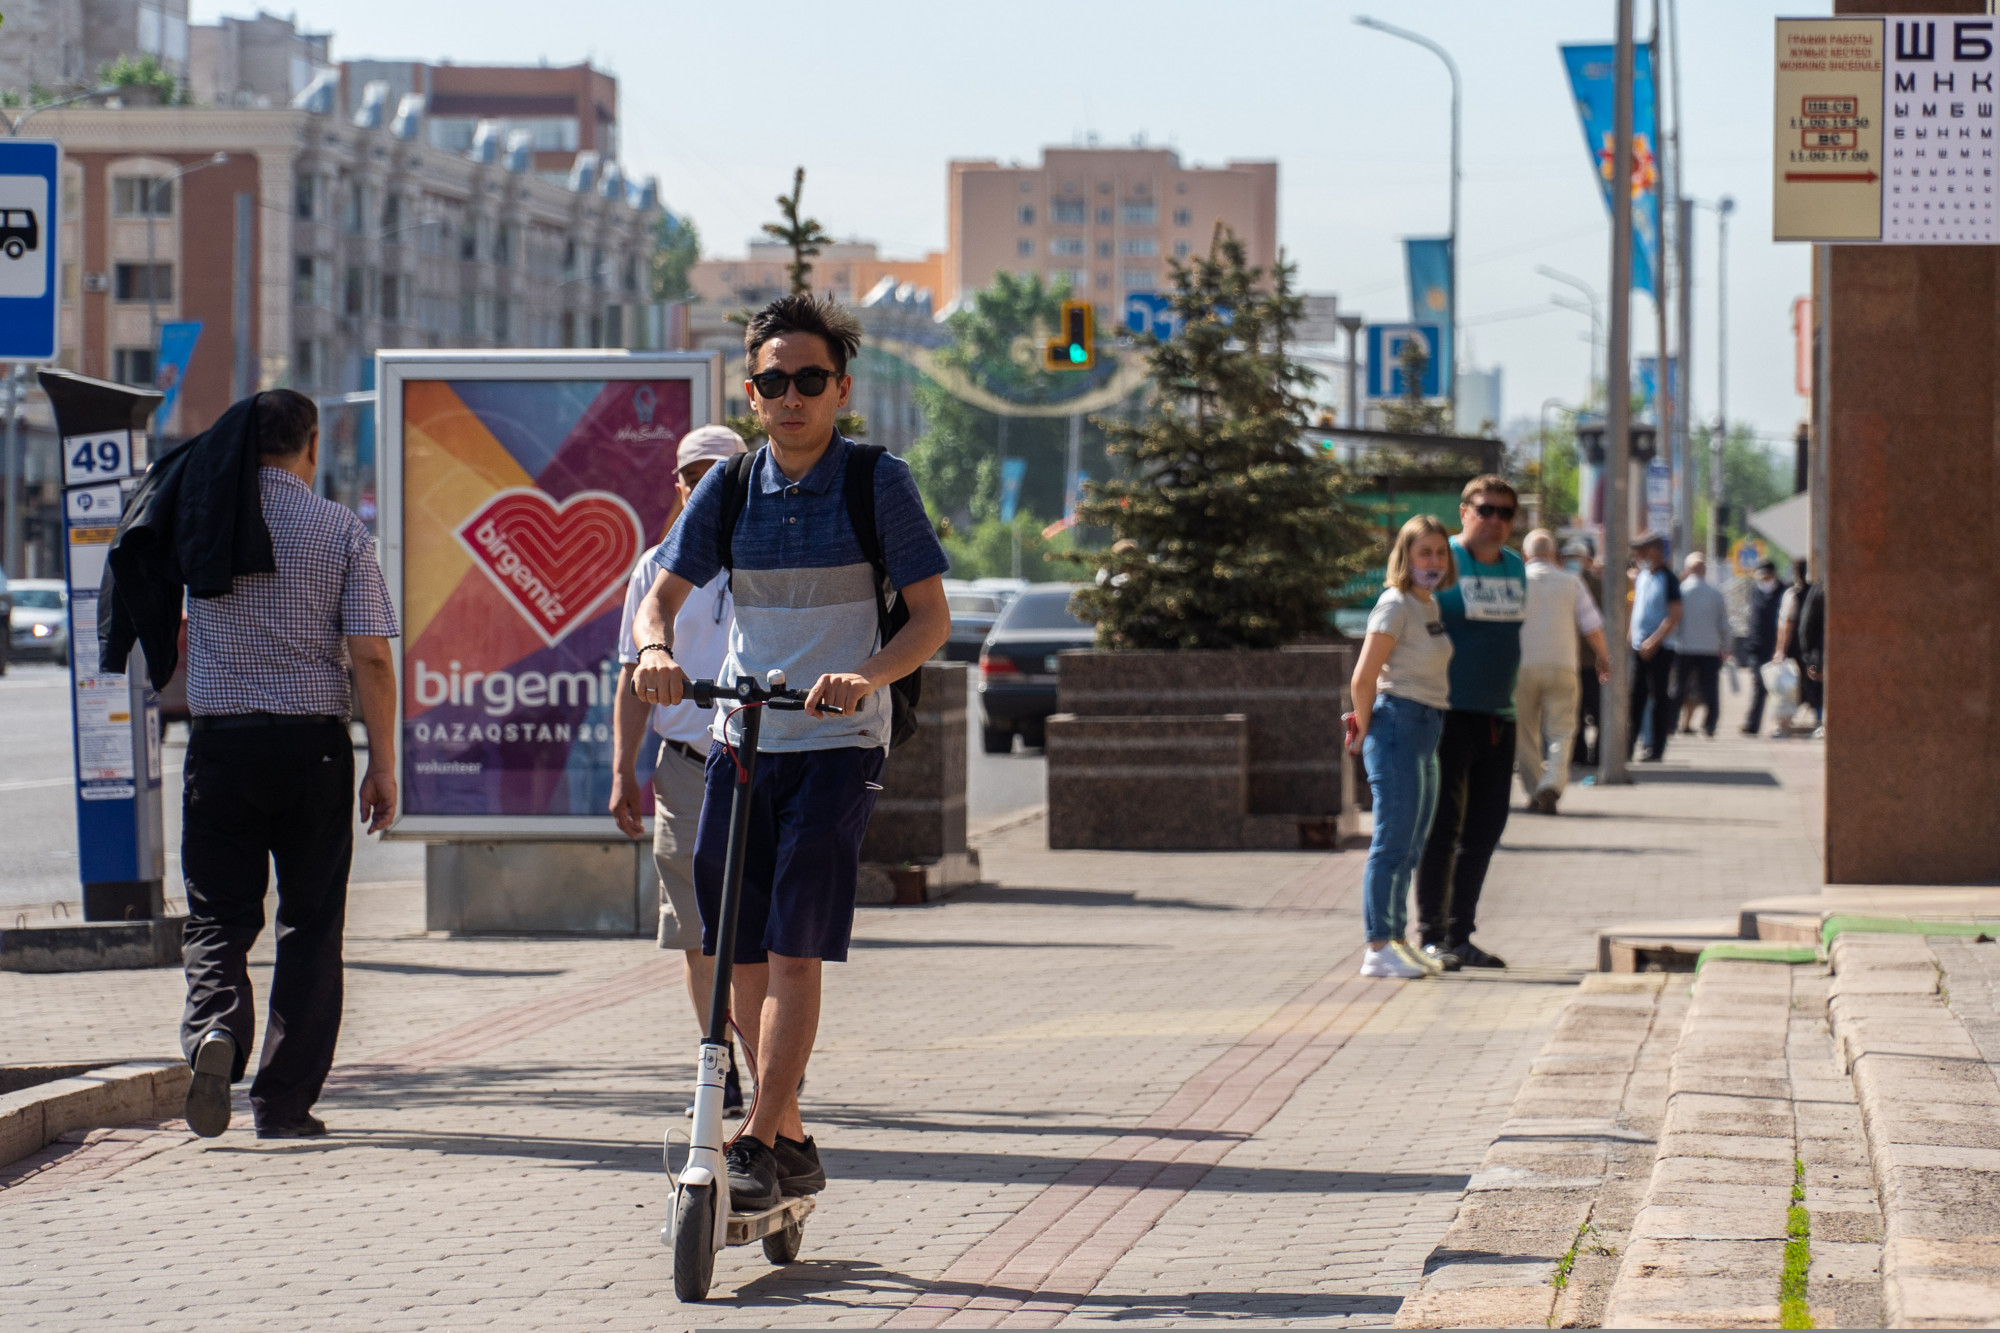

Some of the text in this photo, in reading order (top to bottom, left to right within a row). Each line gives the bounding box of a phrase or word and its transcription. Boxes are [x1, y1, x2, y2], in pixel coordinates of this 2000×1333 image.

[1830, 34, 1873, 45] РАБОТЫ
[1896, 22, 1994, 62] Ш Б
[1780, 61, 1826, 71] WORKING
[1895, 72, 1993, 93] М Н К
[1894, 102, 1992, 118] Ы М Б Ш
[72, 439, 121, 473] 49
[474, 518, 566, 624] birgemiz
[415, 660, 620, 716] birgemi
[415, 722, 613, 744] QAZAQSTAN 20
[415, 760, 482, 775] volunteer
